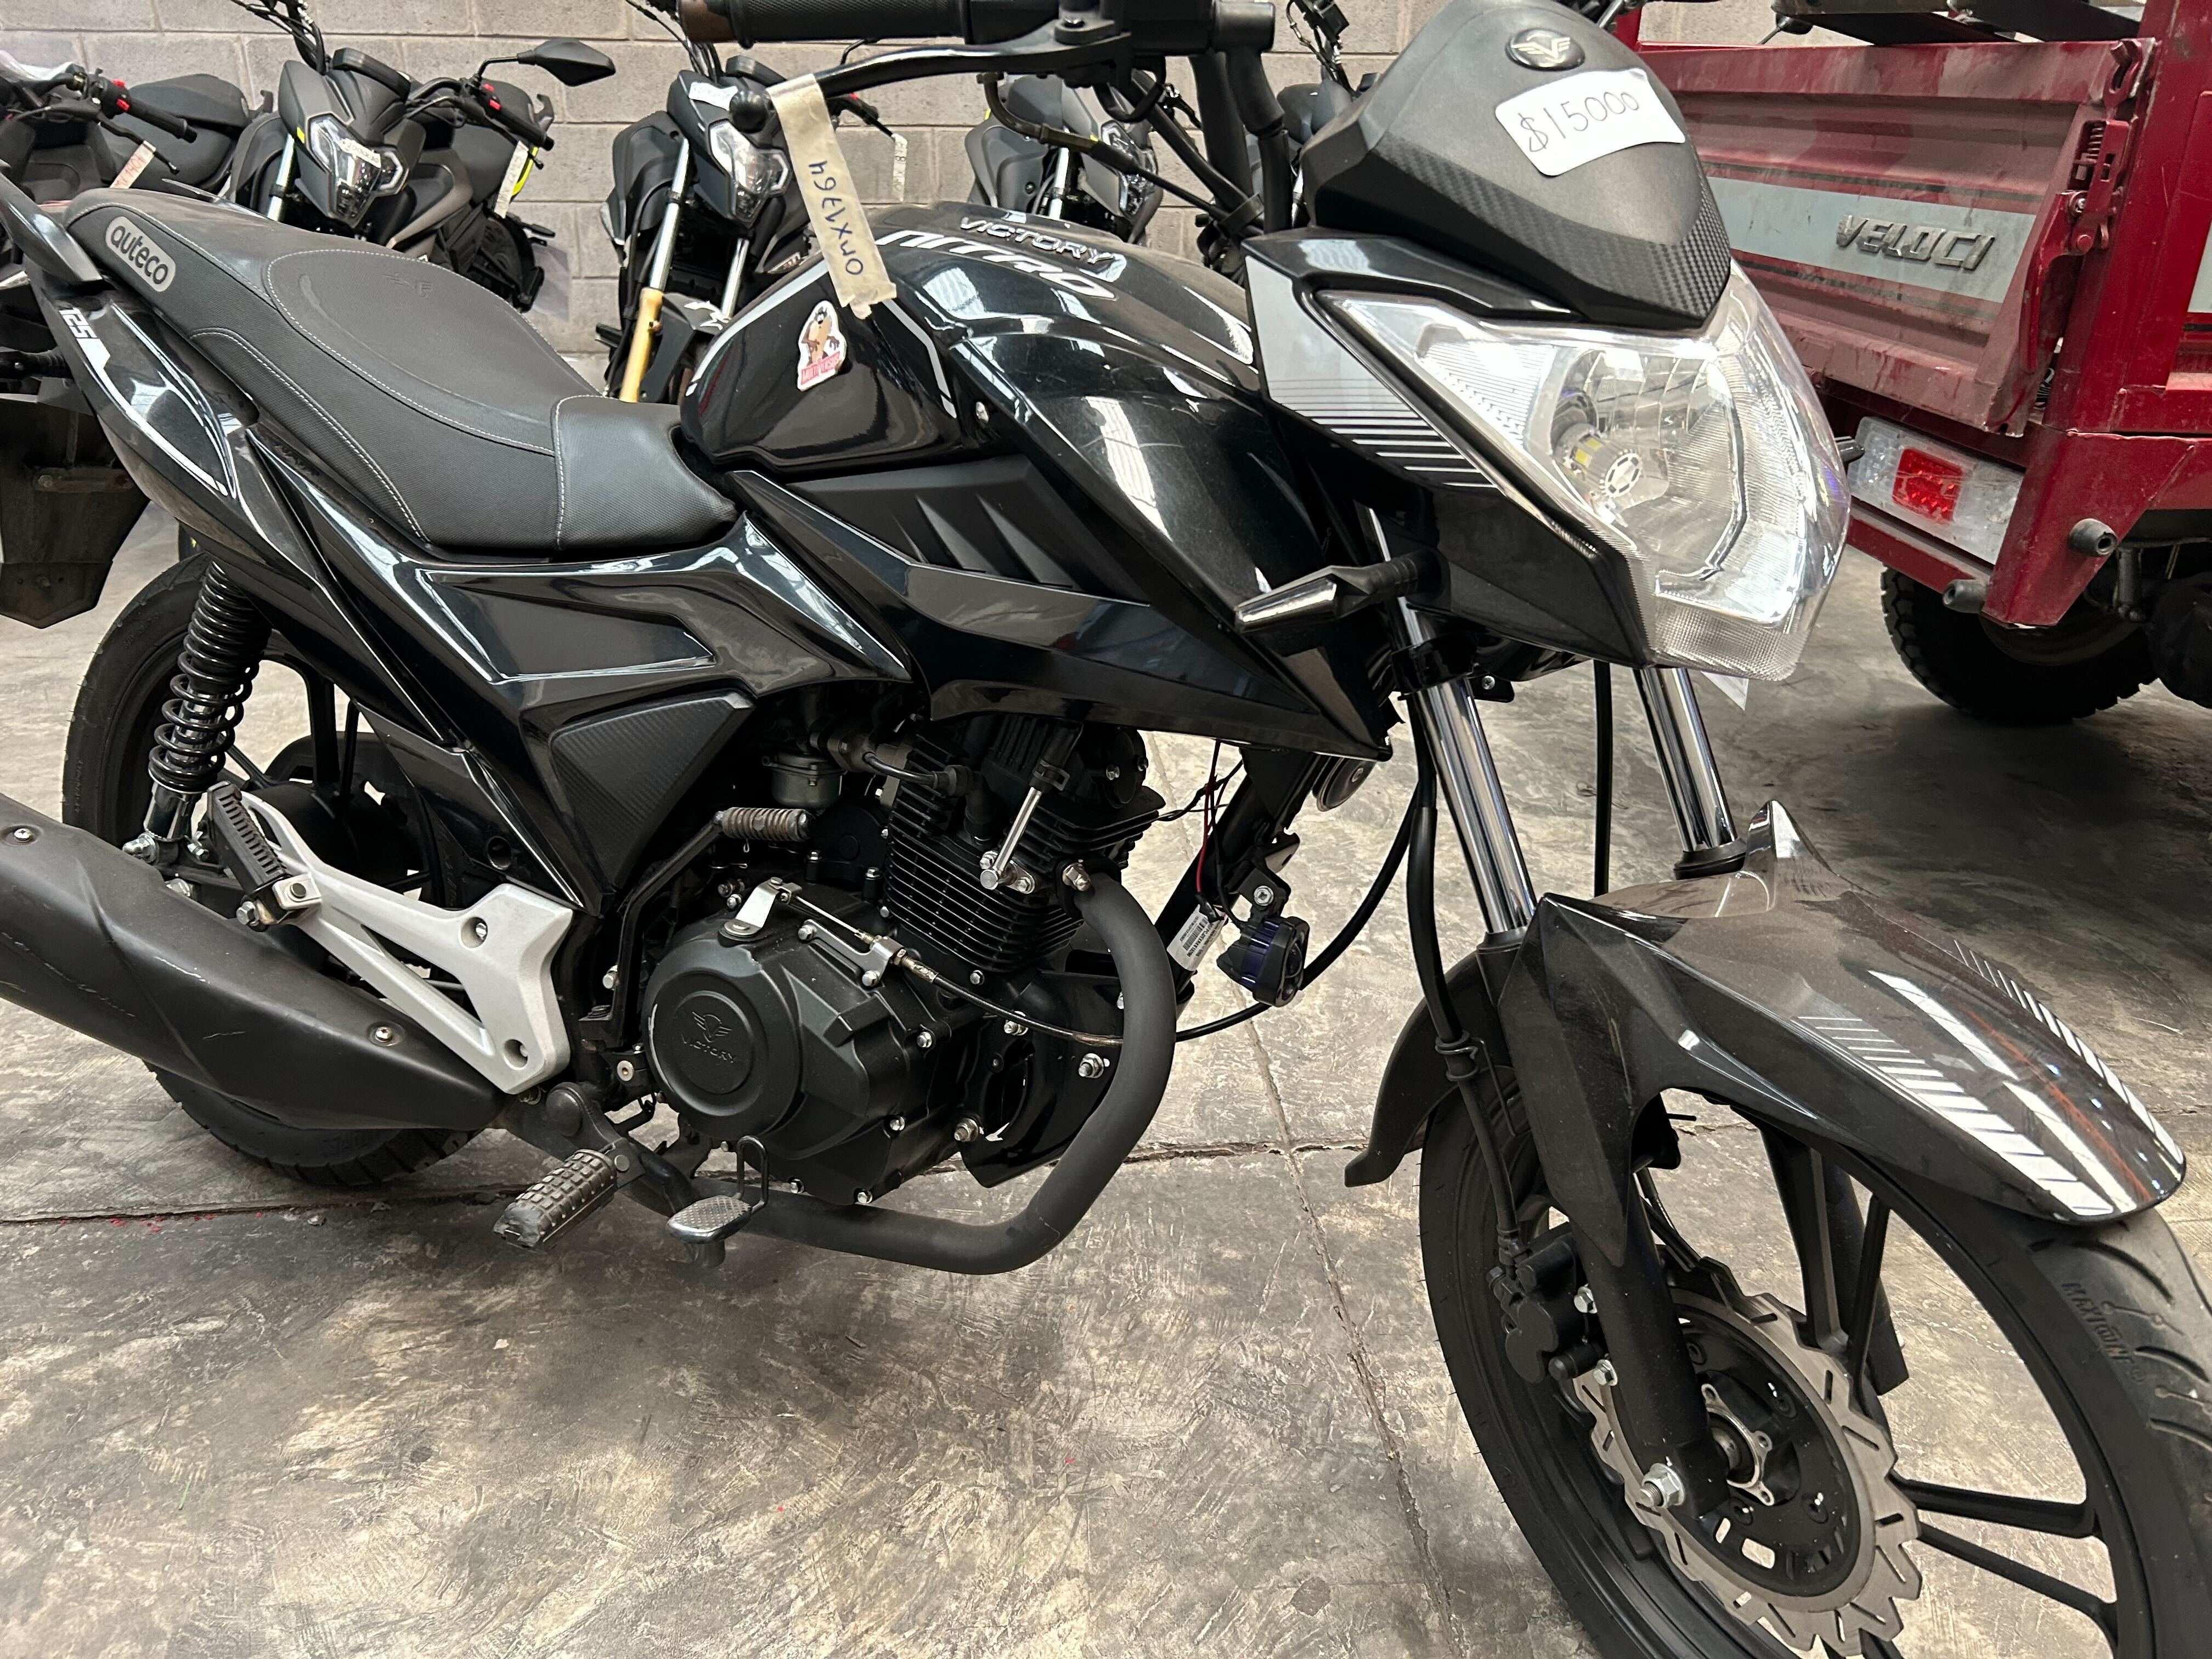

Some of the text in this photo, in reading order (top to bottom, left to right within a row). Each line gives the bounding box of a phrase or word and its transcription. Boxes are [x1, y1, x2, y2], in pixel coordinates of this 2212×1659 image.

[1518, 91, 1640, 153] $15000
[110, 225, 168, 285] auteco
[960, 216, 1115, 264] VICTORY
[1836, 214, 1997, 271] VELOCI
[59, 307, 98, 338] 125
